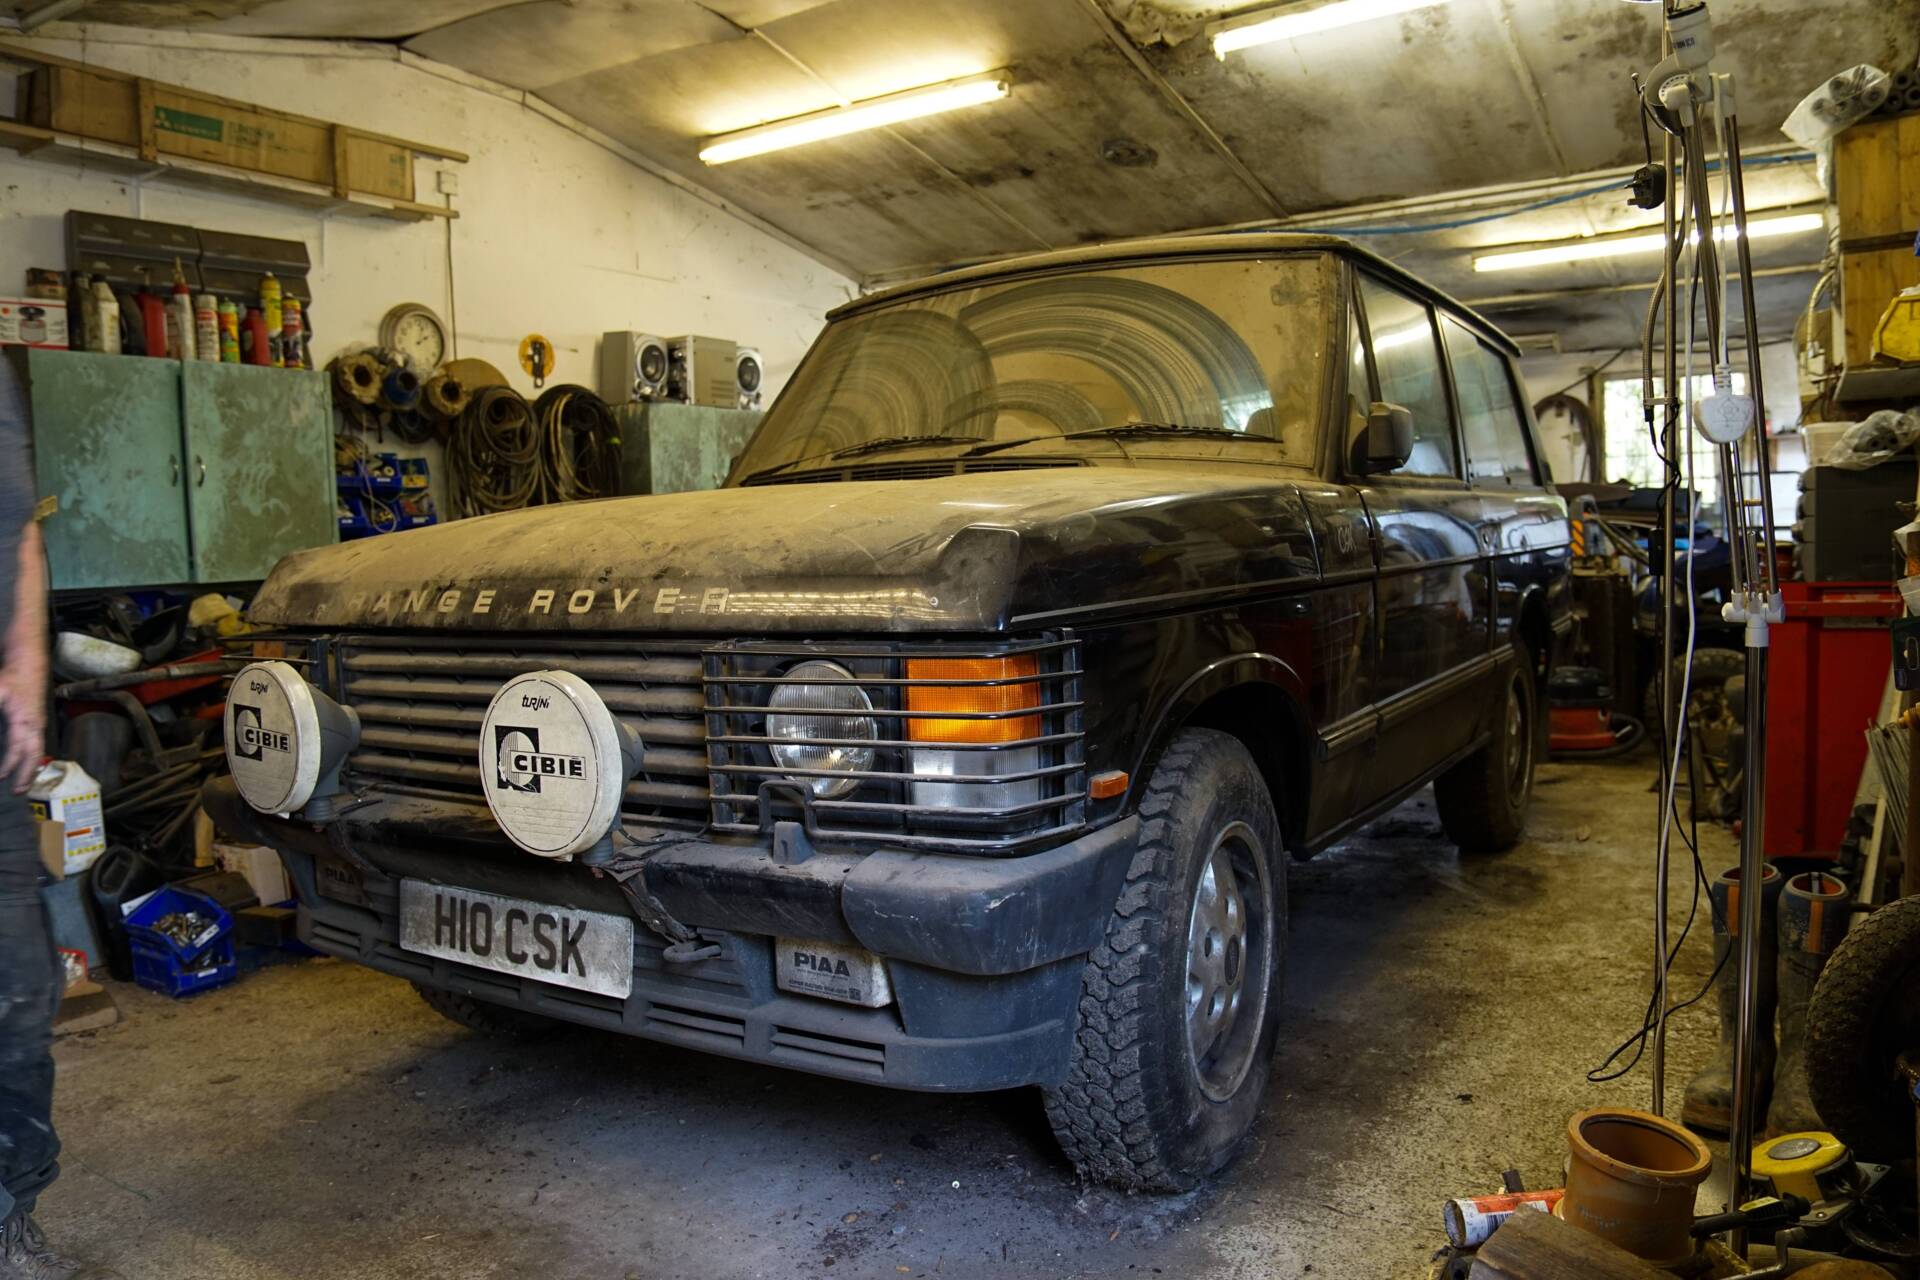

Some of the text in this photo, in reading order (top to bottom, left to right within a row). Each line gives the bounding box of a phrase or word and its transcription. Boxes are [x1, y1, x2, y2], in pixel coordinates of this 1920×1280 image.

[528, 587, 731, 615] ROVER
[434, 893, 588, 978] H10 CSK
[794, 951, 851, 977] PIAA
